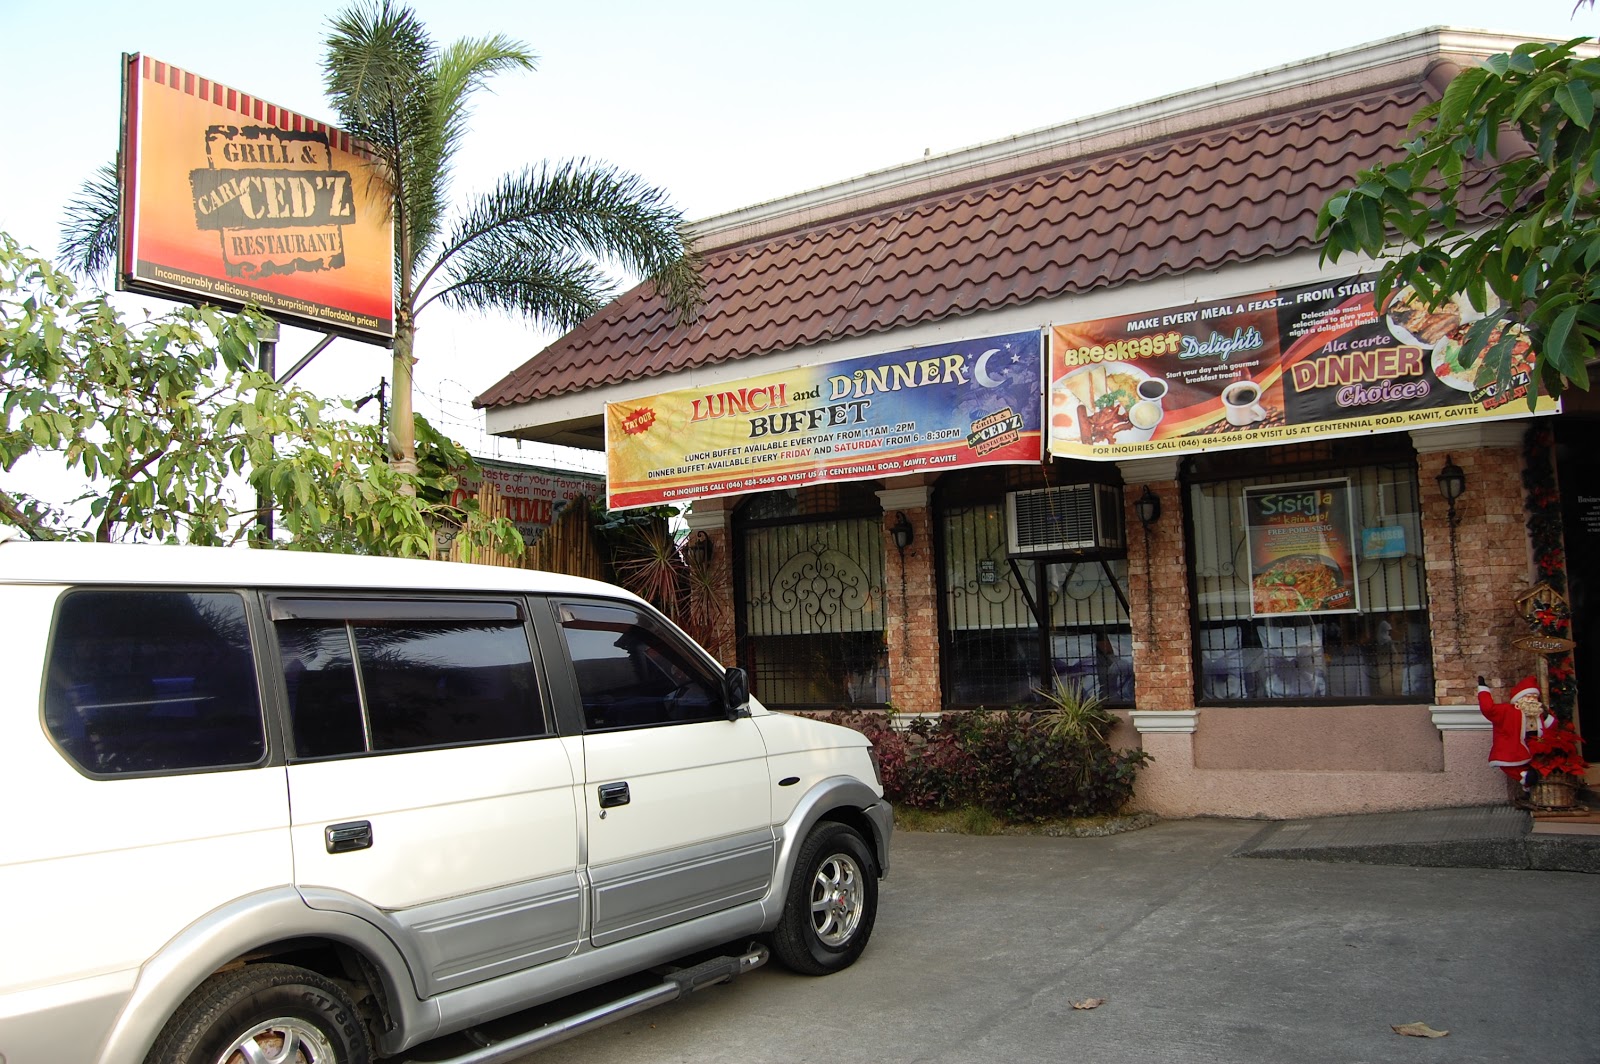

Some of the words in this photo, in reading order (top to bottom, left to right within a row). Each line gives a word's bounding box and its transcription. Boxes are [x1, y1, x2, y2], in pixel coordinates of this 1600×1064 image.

[223, 143, 294, 164] GRILL
[301, 145, 317, 164] &
[239, 176, 350, 220] CED'Z
[231, 232, 337, 256] RESTAURANT
[155, 267, 213, 291] Incomparably
[215, 280, 249, 298] delicious
[251, 290, 275, 306] meals,
[277, 297, 319, 316] surprisingly
[320, 307, 355, 323] affordable
[357, 315, 378, 328] prices!
[1127, 319, 1159, 332] MAKE
[1163, 311, 1198, 325] EVERY
[1201, 306, 1233, 320] MEAL
[1236, 304, 1244, 313] A
[1297, 288, 1334, 303] FROM
[1338, 281, 1375, 297] START
[1293, 318, 1328, 328] selections
[1340, 313, 1355, 322] give
[1357, 311, 1374, 319] your
[1301, 308, 1341, 319] Delectable
[1343, 304, 1361, 313] meal
[1289, 326, 1309, 337] night
[1317, 321, 1353, 332] delightful
[1355, 317, 1379, 326] finish!
[1180, 327, 1262, 359] Delights
[1323, 340, 1347, 354] Ala
[1351, 335, 1390, 348] carte
[1166, 371, 1181, 379] Start
[1183, 369, 1197, 377] your
[1199, 367, 1212, 375] day
[1213, 364, 1228, 372] with
[1230, 360, 1259, 370] gourmet
[1186, 374, 1217, 384] breakfast
[1219, 371, 1241, 379] treats!
[1292, 345, 1423, 391] DINNER
[690, 383, 788, 423] LUNCH
[793, 385, 820, 402] and
[1338, 380, 1429, 406] Choices
[624, 420, 639, 431] TRY
[639, 413, 653, 425] OUR
[749, 400, 871, 438] BUFFET
[980, 416, 1020, 440] CED'Z
[1112, 444, 1155, 453] INQUIRIES
[1178, 439, 1200, 449] (046)
[1202, 434, 1242, 444] 484-5668
[1245, 432, 1258, 440] OR
[1260, 429, 1283, 438] VISIT
[1286, 427, 1297, 435] US
[1300, 426, 1311, 434] AT
[1314, 419, 1373, 432] CENTENNIAL
[1376, 415, 1406, 425] ROAD,
[1409, 410, 1442, 422] KAWIT,
[1445, 406, 1479, 418] CAVITE
[685, 452, 710, 462] LUNCH
[713, 447, 741, 457] BUFFET
[744, 440, 787, 453] AVAILABLE
[791, 434, 834, 447] EVERYDAY
[837, 430, 861, 440] FROM
[864, 427, 887, 436] 11AM
[896, 423, 915, 432] 2PM
[980, 432, 1015, 450] RESTAURANT
[648, 468, 675, 478] DINNER
[677, 463, 705, 474] BUFFET
[707, 457, 749, 470] AVAILABLE
[751, 453, 778, 464] EVERY
[781, 448, 811, 459] FRIDAY
[814, 446, 831, 455] AND
[834, 439, 883, 452] SATURDAY
[886, 436, 911, 446] FROM
[913, 434, 919, 442] 6
[927, 429, 960, 440] 8:30PM
[482, 467, 510, 481] taste
[513, 473, 524, 482] of
[529, 474, 550, 485] your
[556, 478, 597, 491] favorite
[677, 486, 708, 495] INQUIRIES
[726, 481, 742, 490] (046)
[789, 471, 806, 481] VISIT
[818, 469, 827, 477] AT
[830, 464, 876, 475] CENTENNIAL
[878, 461, 901, 469] ROAD,
[903, 458, 927, 467] KAWIT,
[929, 455, 957, 463] CAVITE
[506, 483, 529, 495] even
[533, 487, 557, 499] more
[500, 496, 552, 524] TIME
[1284, 515, 1305, 524] kain
[1289, 526, 1310, 534] PORK
[1312, 524, 1333, 532] SISIG
[1526, 640, 1562, 649] WELCOME
